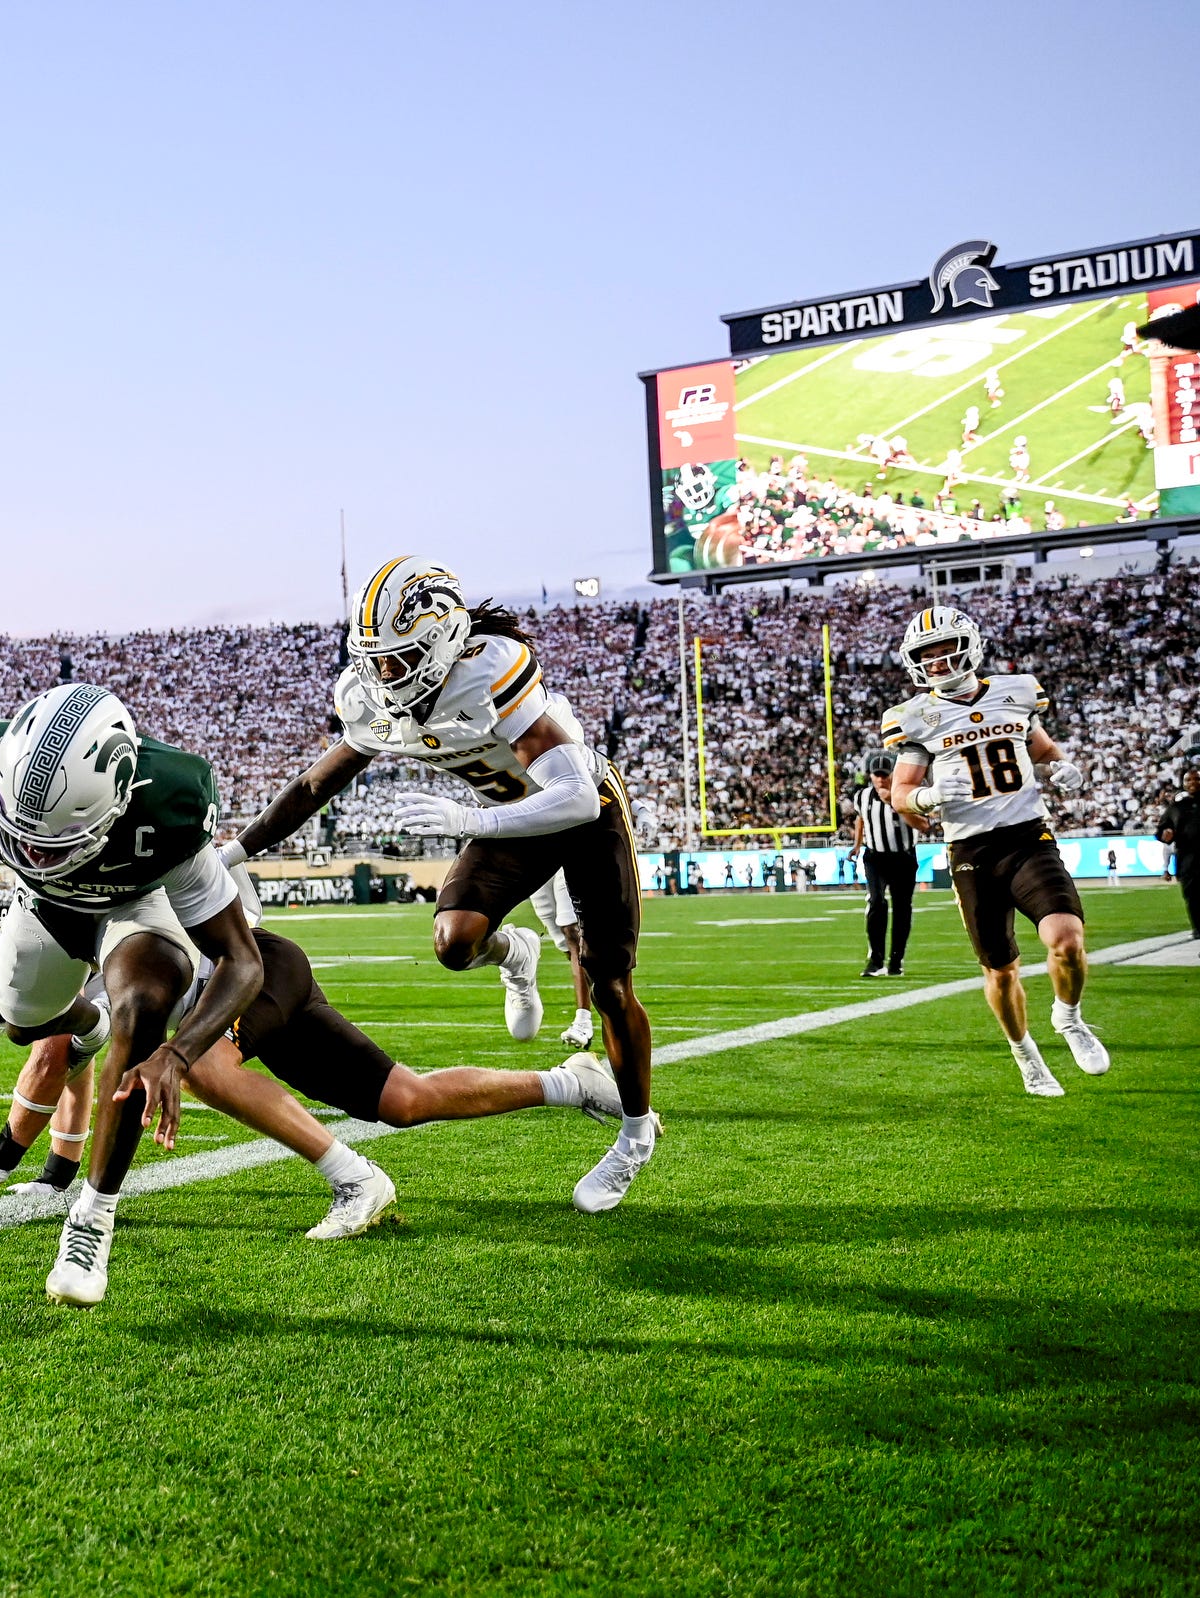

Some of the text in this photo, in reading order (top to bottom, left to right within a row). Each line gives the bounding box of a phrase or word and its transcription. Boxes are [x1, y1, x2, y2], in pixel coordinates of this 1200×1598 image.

[761, 239, 1195, 345] SPARTAN STADIUM
[359, 640, 379, 648] GRIT
[423, 737, 437, 747] W
[943, 722, 1024, 748] BRONCOS
[408, 742, 498, 763] RONCOS
[445, 758, 528, 802] 5
[960, 738, 1023, 799] 18
[134, 825, 155, 857] C
[78, 883, 137, 893] STATE
